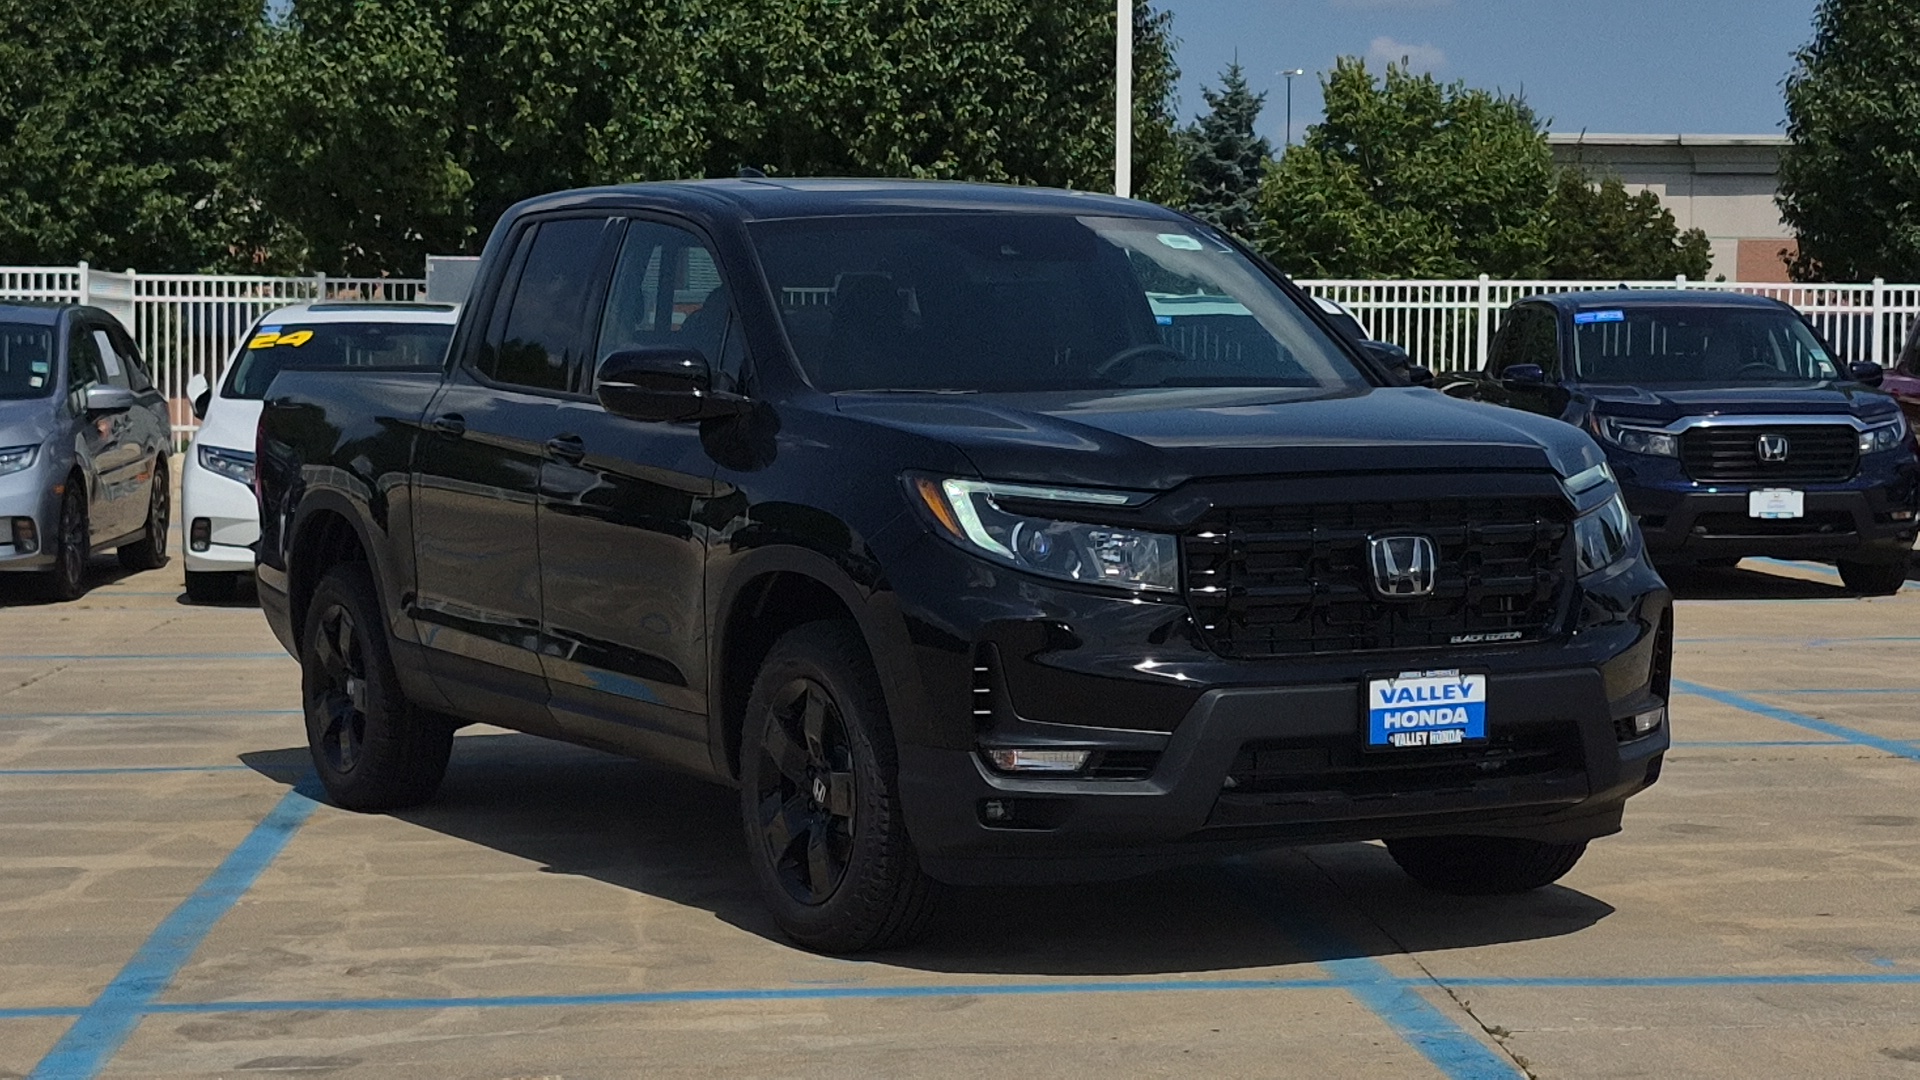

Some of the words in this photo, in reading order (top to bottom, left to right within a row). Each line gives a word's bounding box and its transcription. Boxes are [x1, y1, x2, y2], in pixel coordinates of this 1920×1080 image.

[248, 330, 314, 348] 24
[1450, 634, 1484, 643] BLACK
[1484, 631, 1523, 641] EDITION
[1379, 683, 1474, 704] VALLEY
[1383, 706, 1469, 729] HONDA
[1394, 731, 1428, 747] VALLEY
[1429, 729, 1463, 745] HONDA
